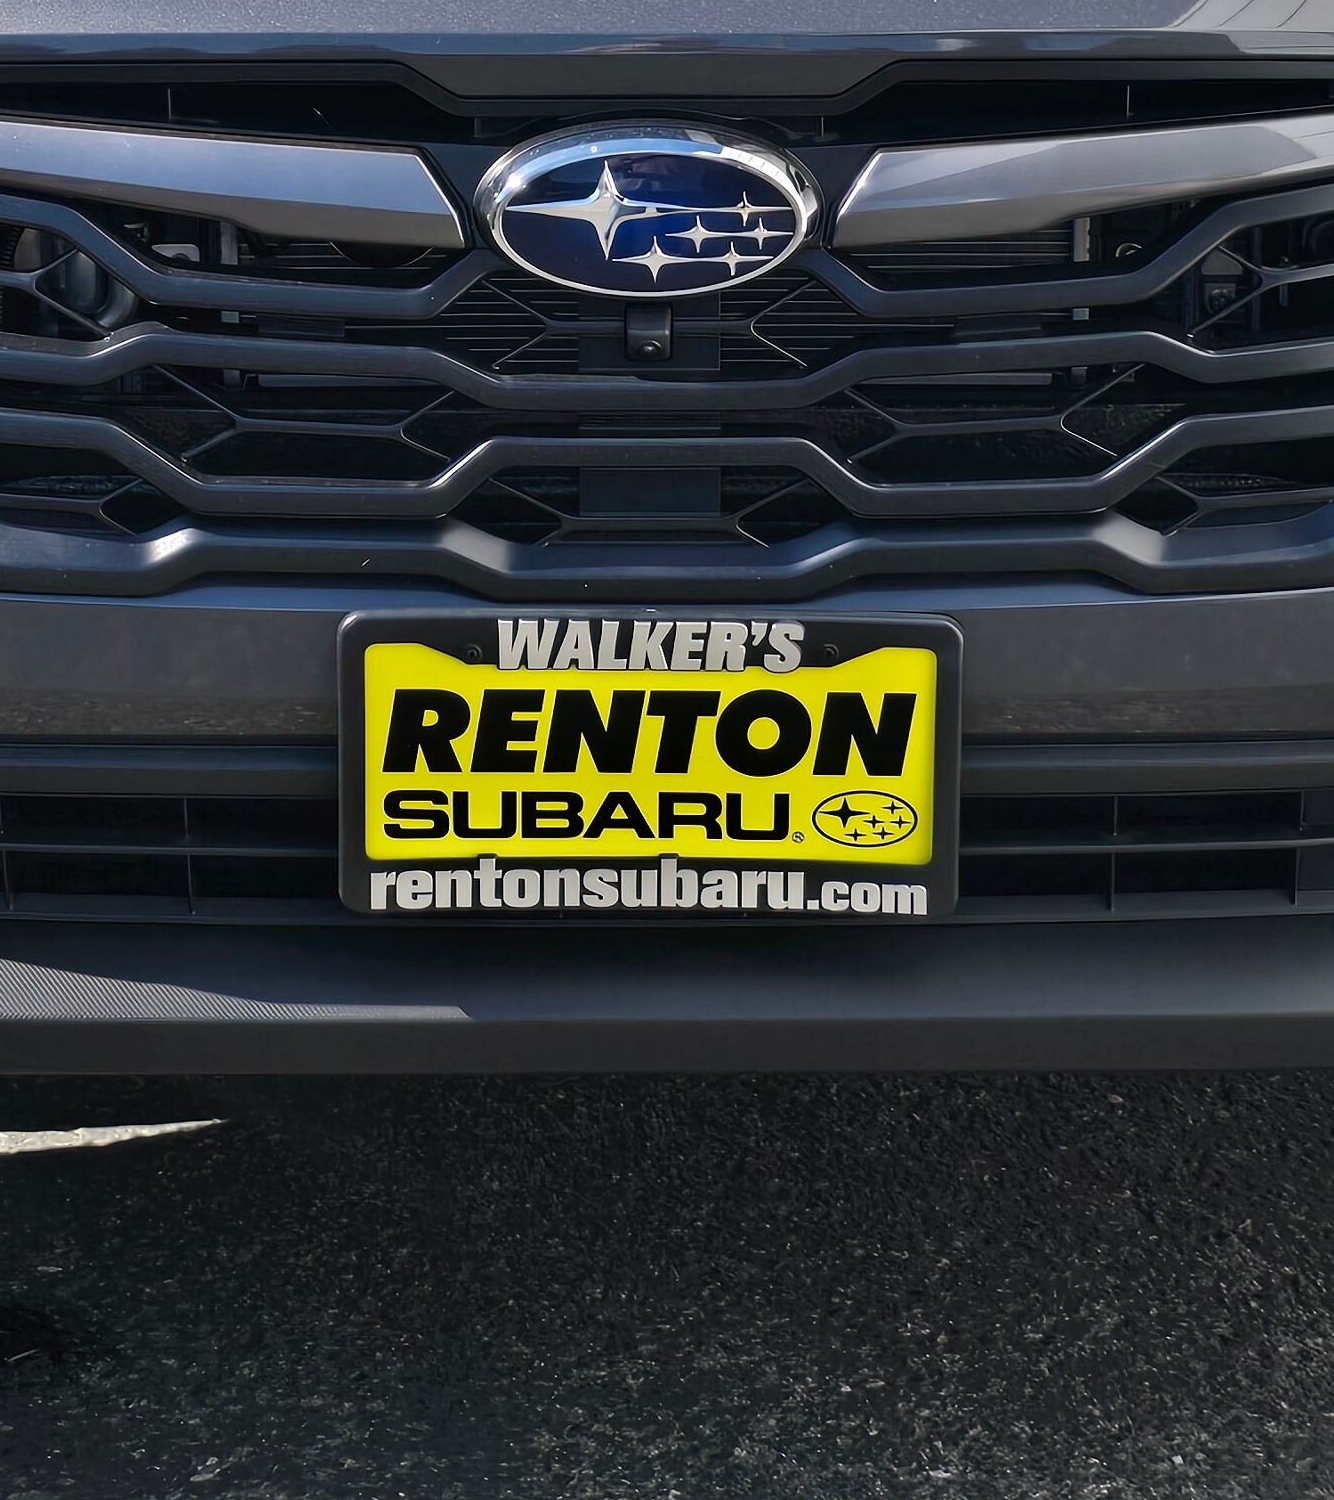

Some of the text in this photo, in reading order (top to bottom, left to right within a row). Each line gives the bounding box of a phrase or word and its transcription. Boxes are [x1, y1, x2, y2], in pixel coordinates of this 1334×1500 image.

[497, 619, 805, 673] WALKER'S
[382, 689, 917, 777] RENTON
[383, 790, 790, 841] SUBARU
[370, 857, 928, 916] rentonsubaru.com
